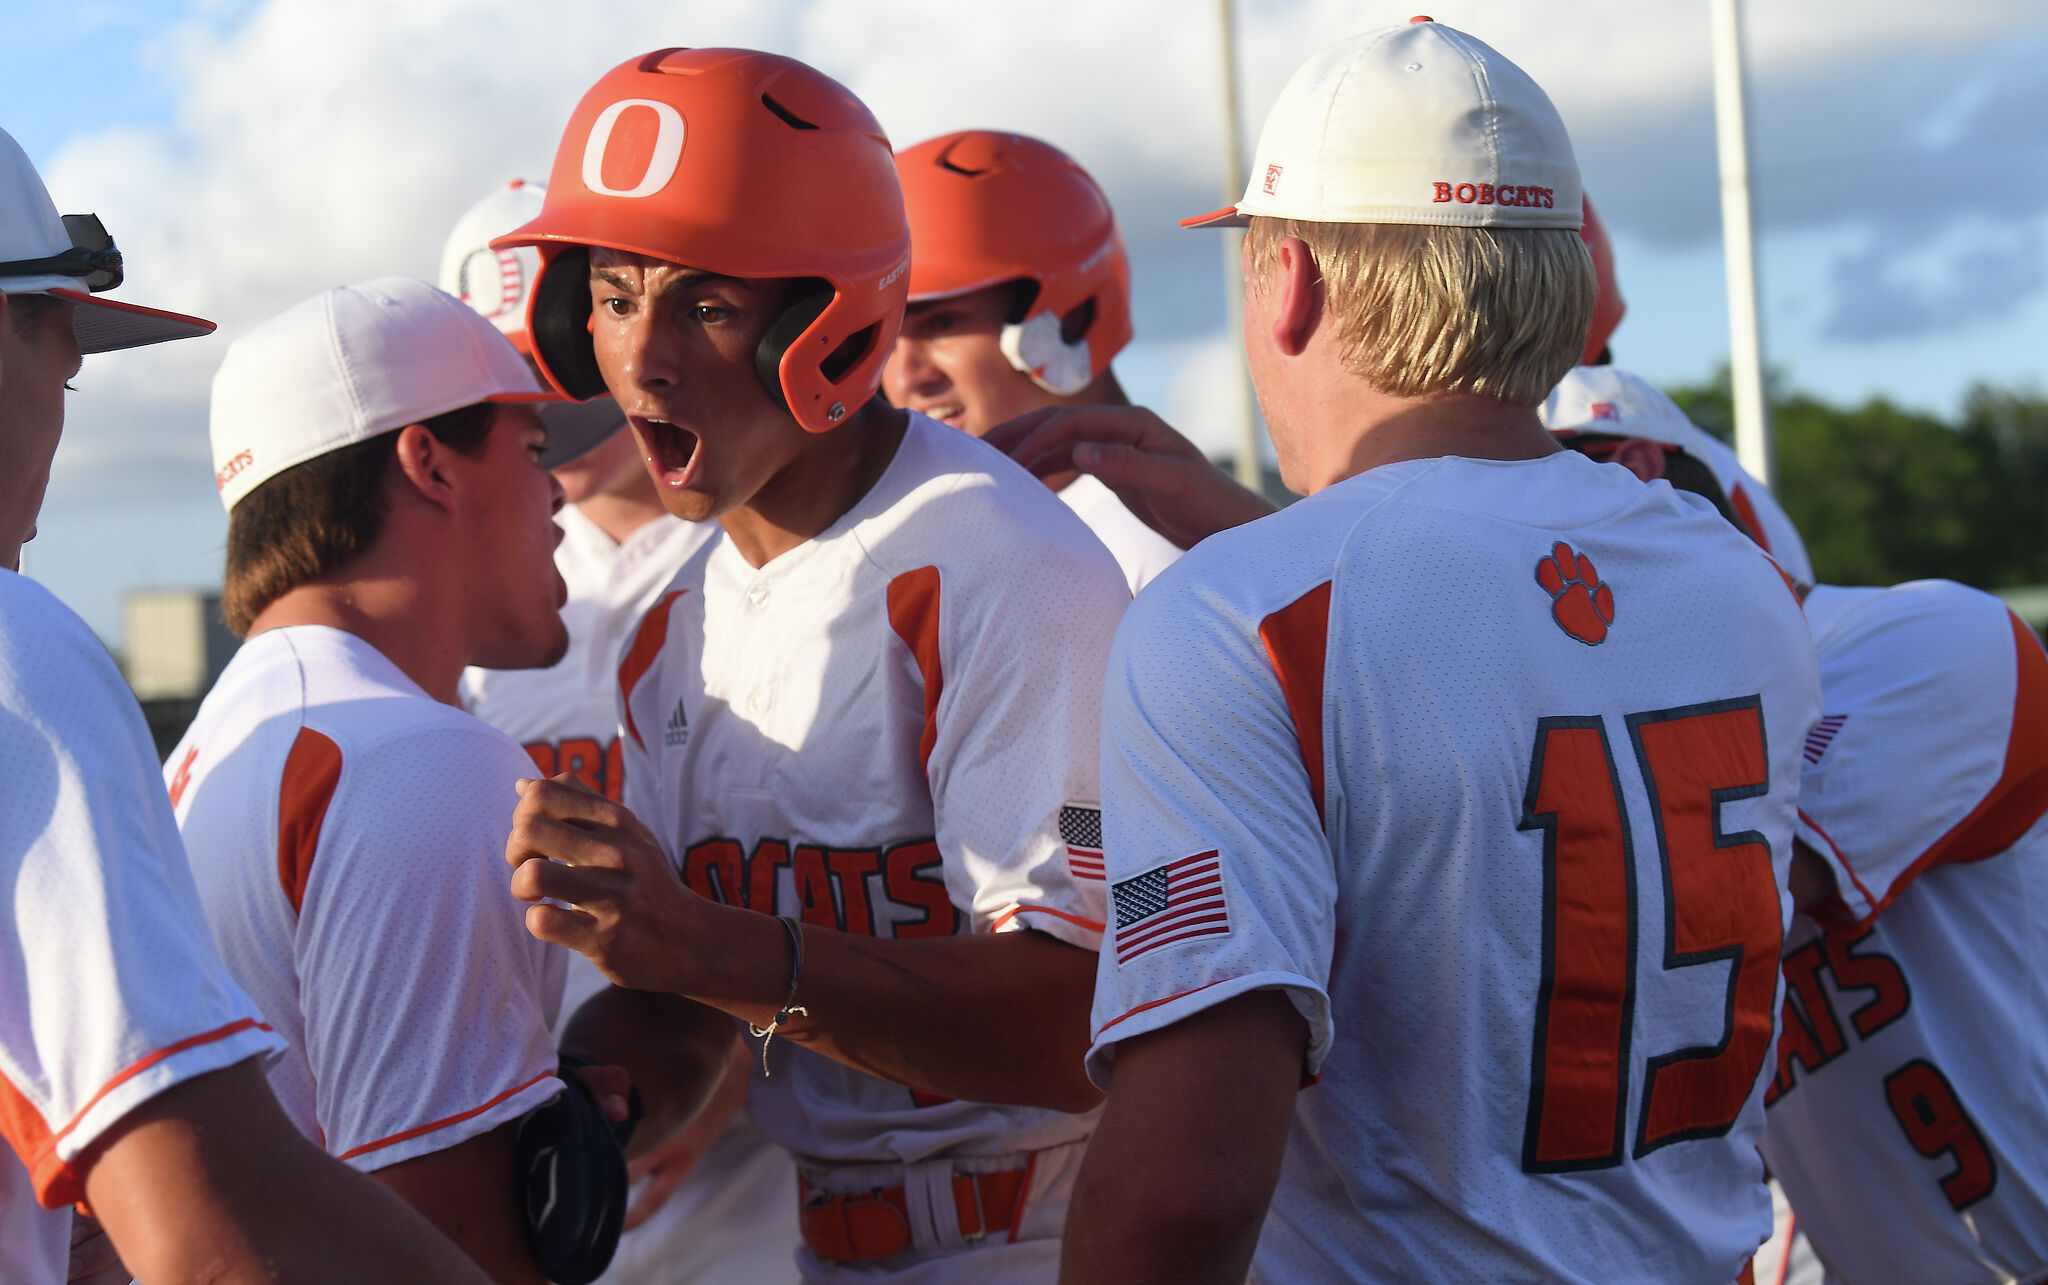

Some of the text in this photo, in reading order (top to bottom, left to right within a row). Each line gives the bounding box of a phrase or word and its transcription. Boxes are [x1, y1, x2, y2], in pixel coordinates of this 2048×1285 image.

[582, 98, 687, 198] O
[1432, 181, 1554, 209] BOBCATS
[1517, 694, 1783, 1174] 15
[1883, 1058, 1997, 1212] 9
